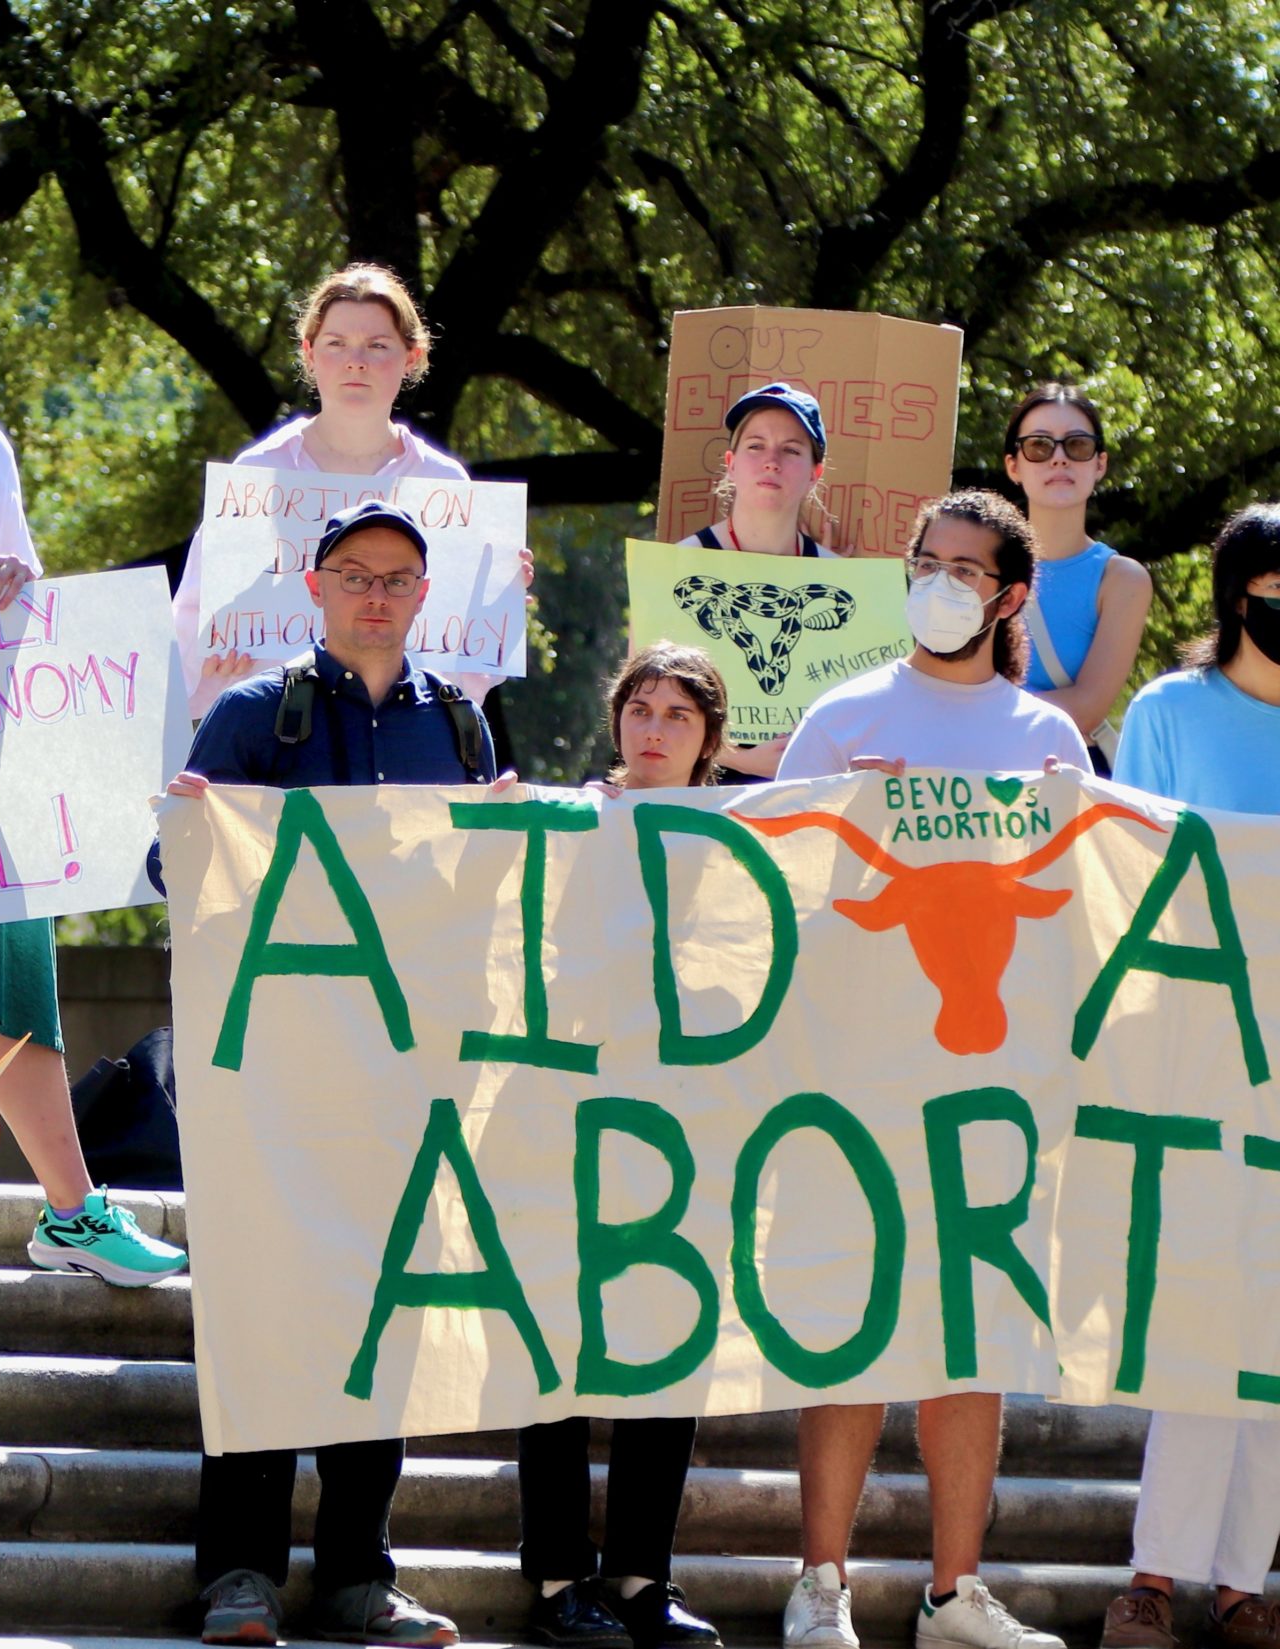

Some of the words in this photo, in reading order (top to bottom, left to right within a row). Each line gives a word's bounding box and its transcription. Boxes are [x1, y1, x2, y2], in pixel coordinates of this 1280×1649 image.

[674, 374, 938, 440] BIES
[420, 488, 474, 528] ON
[666, 478, 937, 556] FURE
[207, 610, 327, 650] WITHOU
[405, 612, 508, 668] OLOGY
[885, 777, 972, 810] BEVO
[892, 807, 1052, 843] ABORTION
[211, 788, 798, 1073] AID
